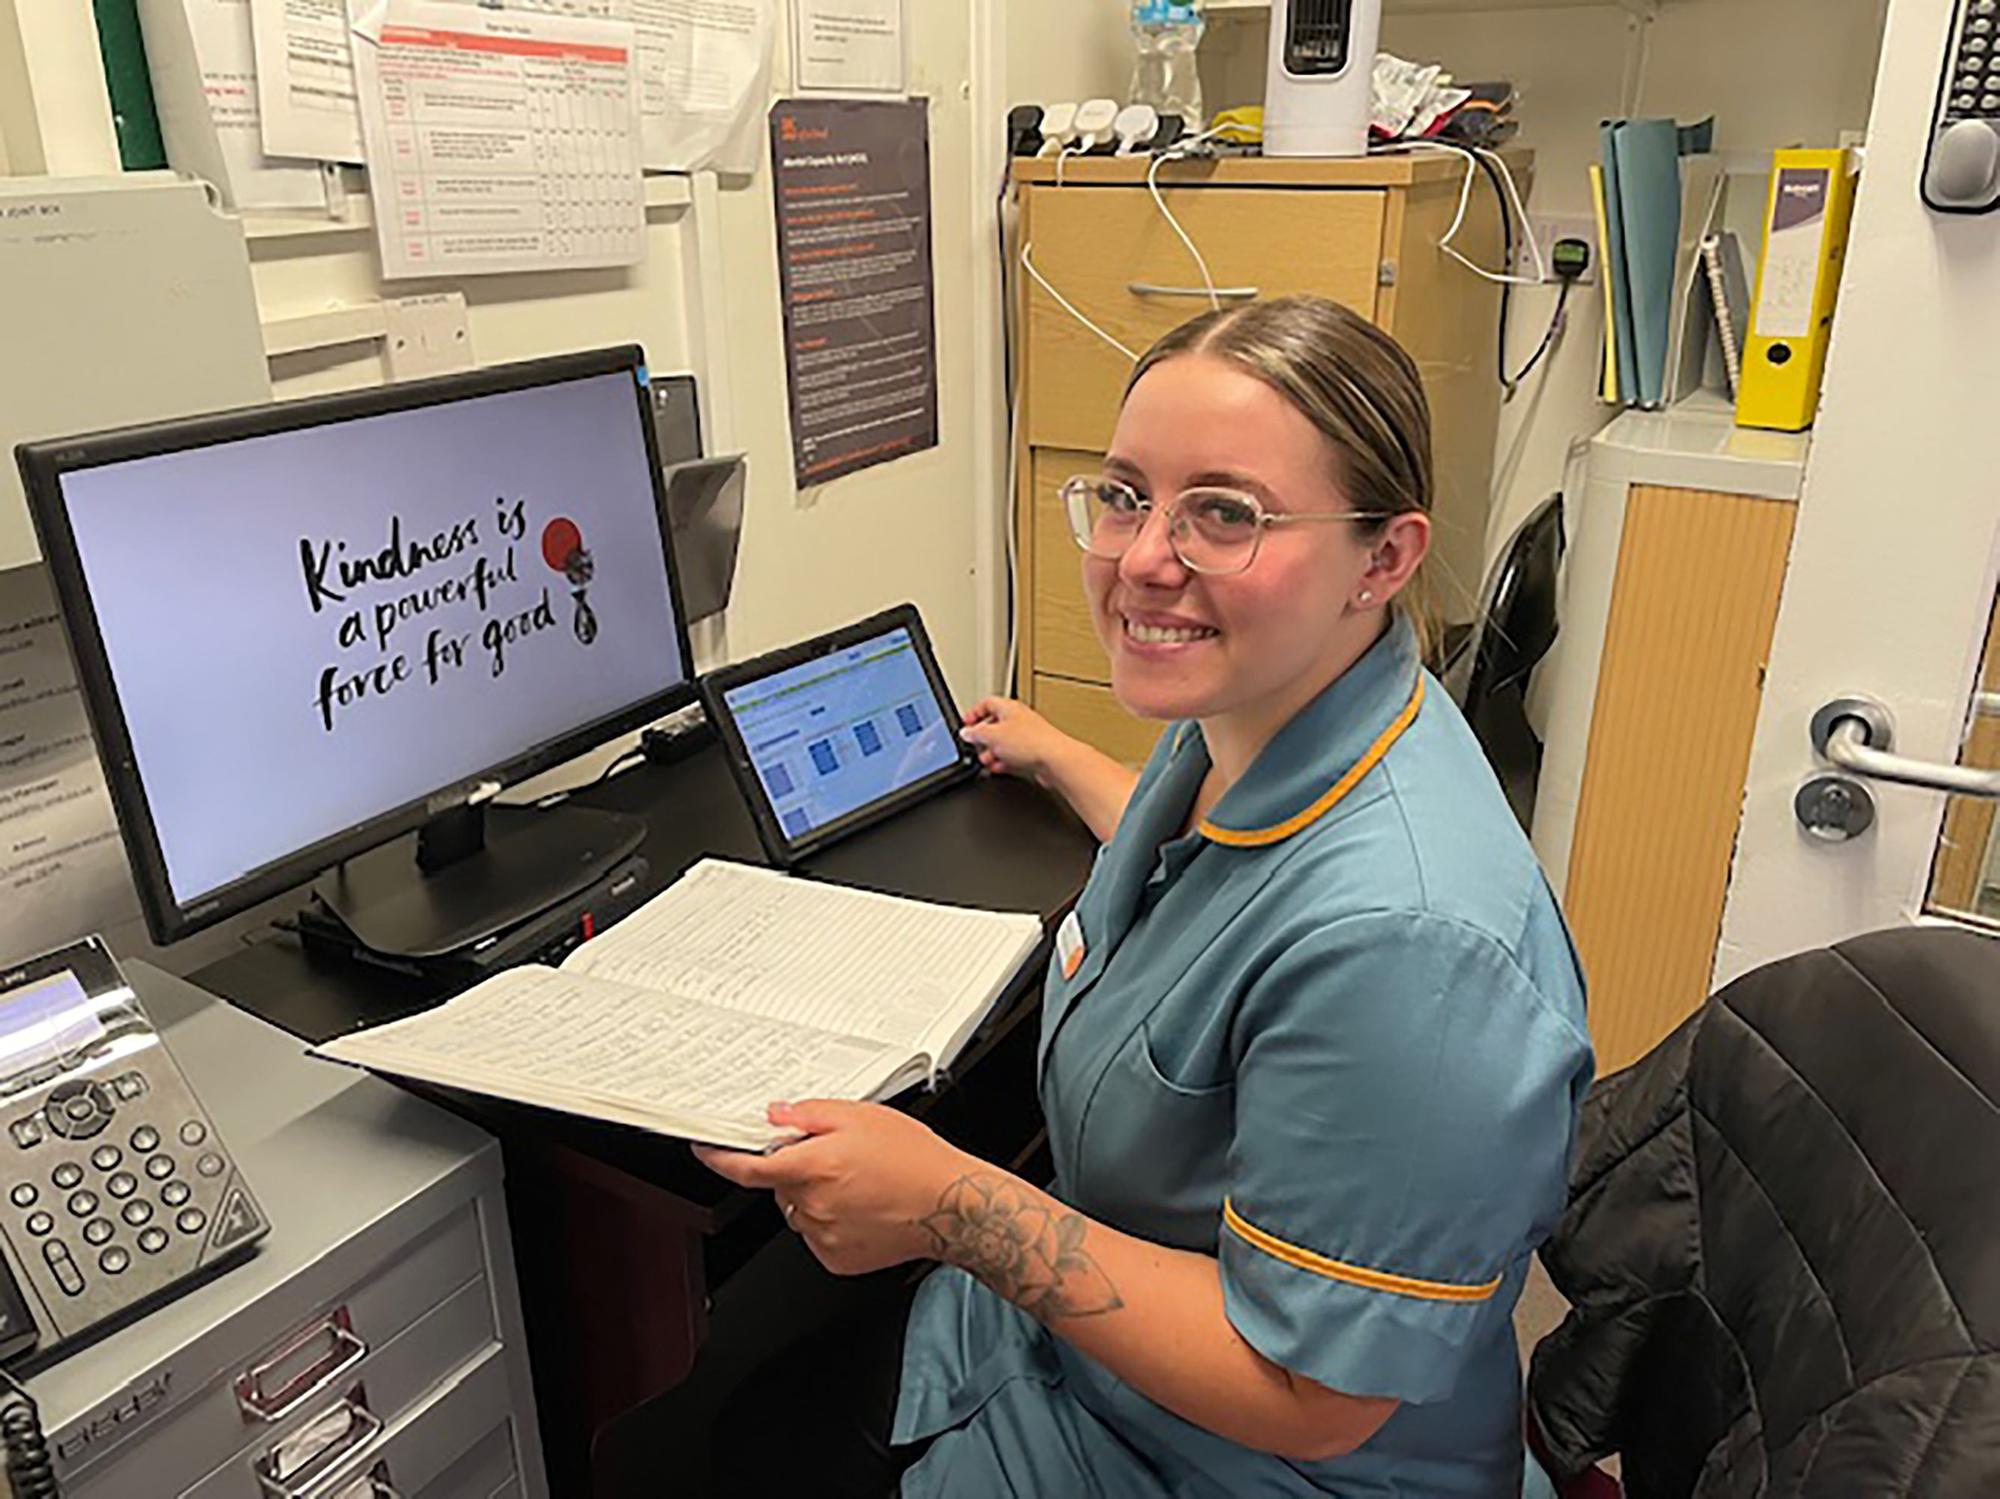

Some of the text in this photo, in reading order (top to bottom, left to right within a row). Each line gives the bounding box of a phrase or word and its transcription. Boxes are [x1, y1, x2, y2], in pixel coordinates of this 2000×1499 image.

[300, 497, 526, 612] Kindness is
[338, 546, 518, 651] a powerful
[313, 587, 556, 731] force for good
